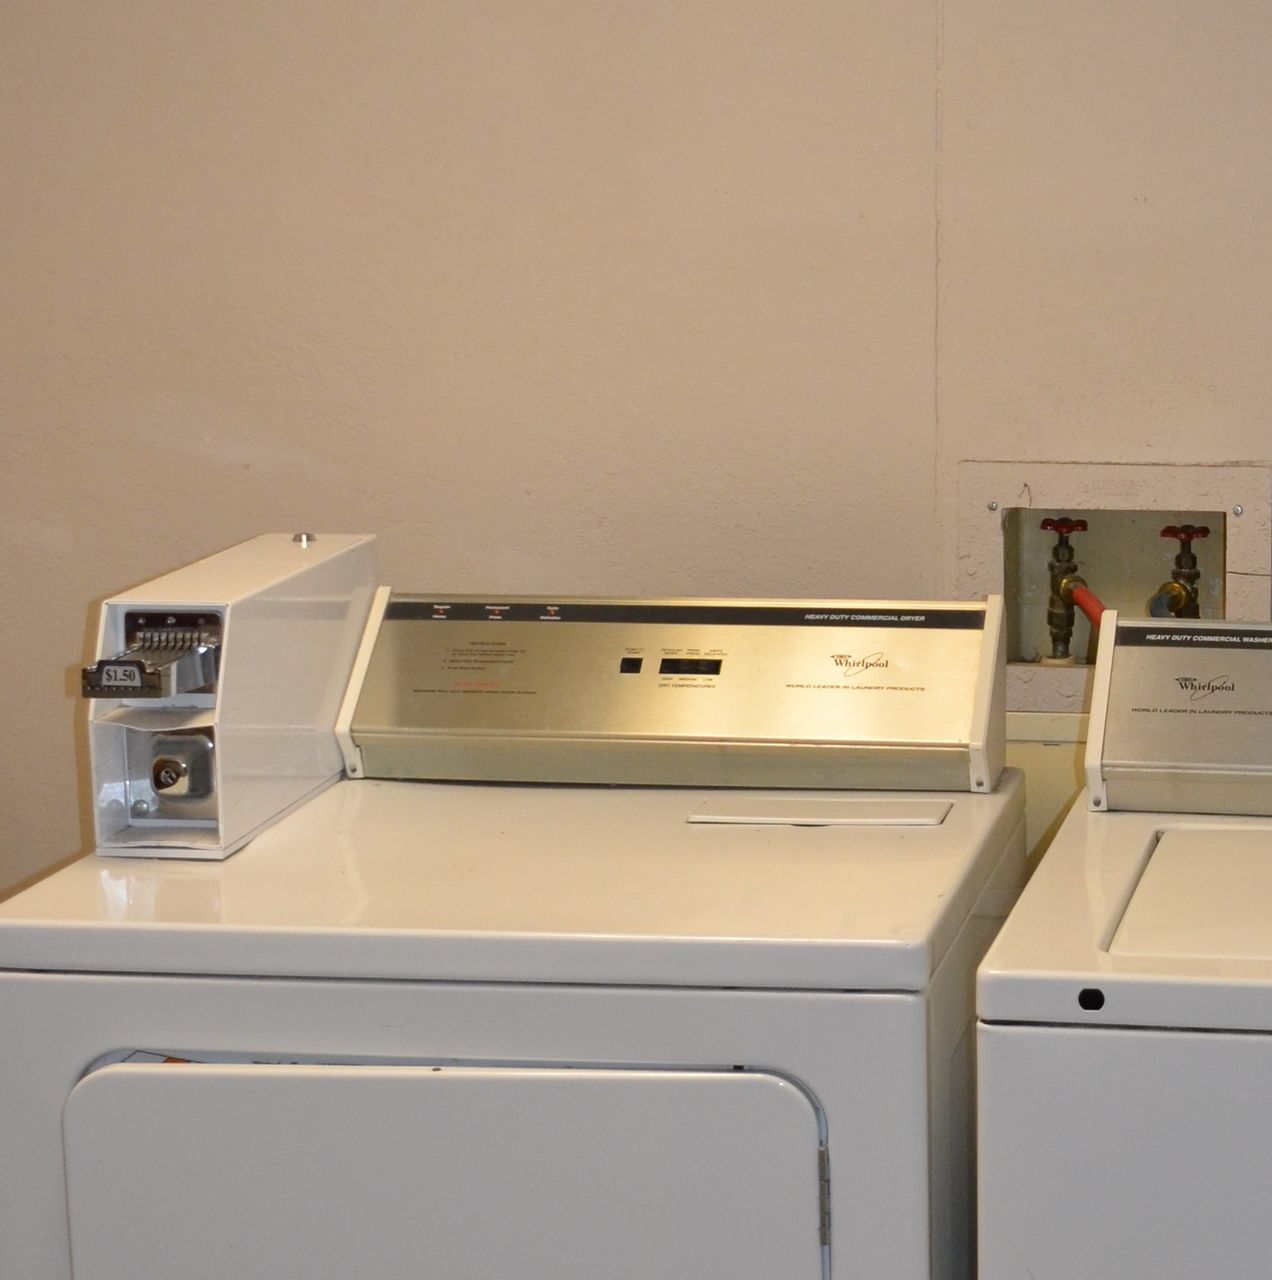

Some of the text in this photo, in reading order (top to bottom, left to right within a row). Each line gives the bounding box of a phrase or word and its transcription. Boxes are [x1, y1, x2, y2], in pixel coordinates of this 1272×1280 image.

[1145, 633, 1171, 641] HEAVY
[1192, 635, 1241, 643] COMMERCIAL
[833, 658, 889, 670] Whirlpool
[105, 669, 136, 683] $1.50
[1179, 682, 1235, 693] Whirlpool
